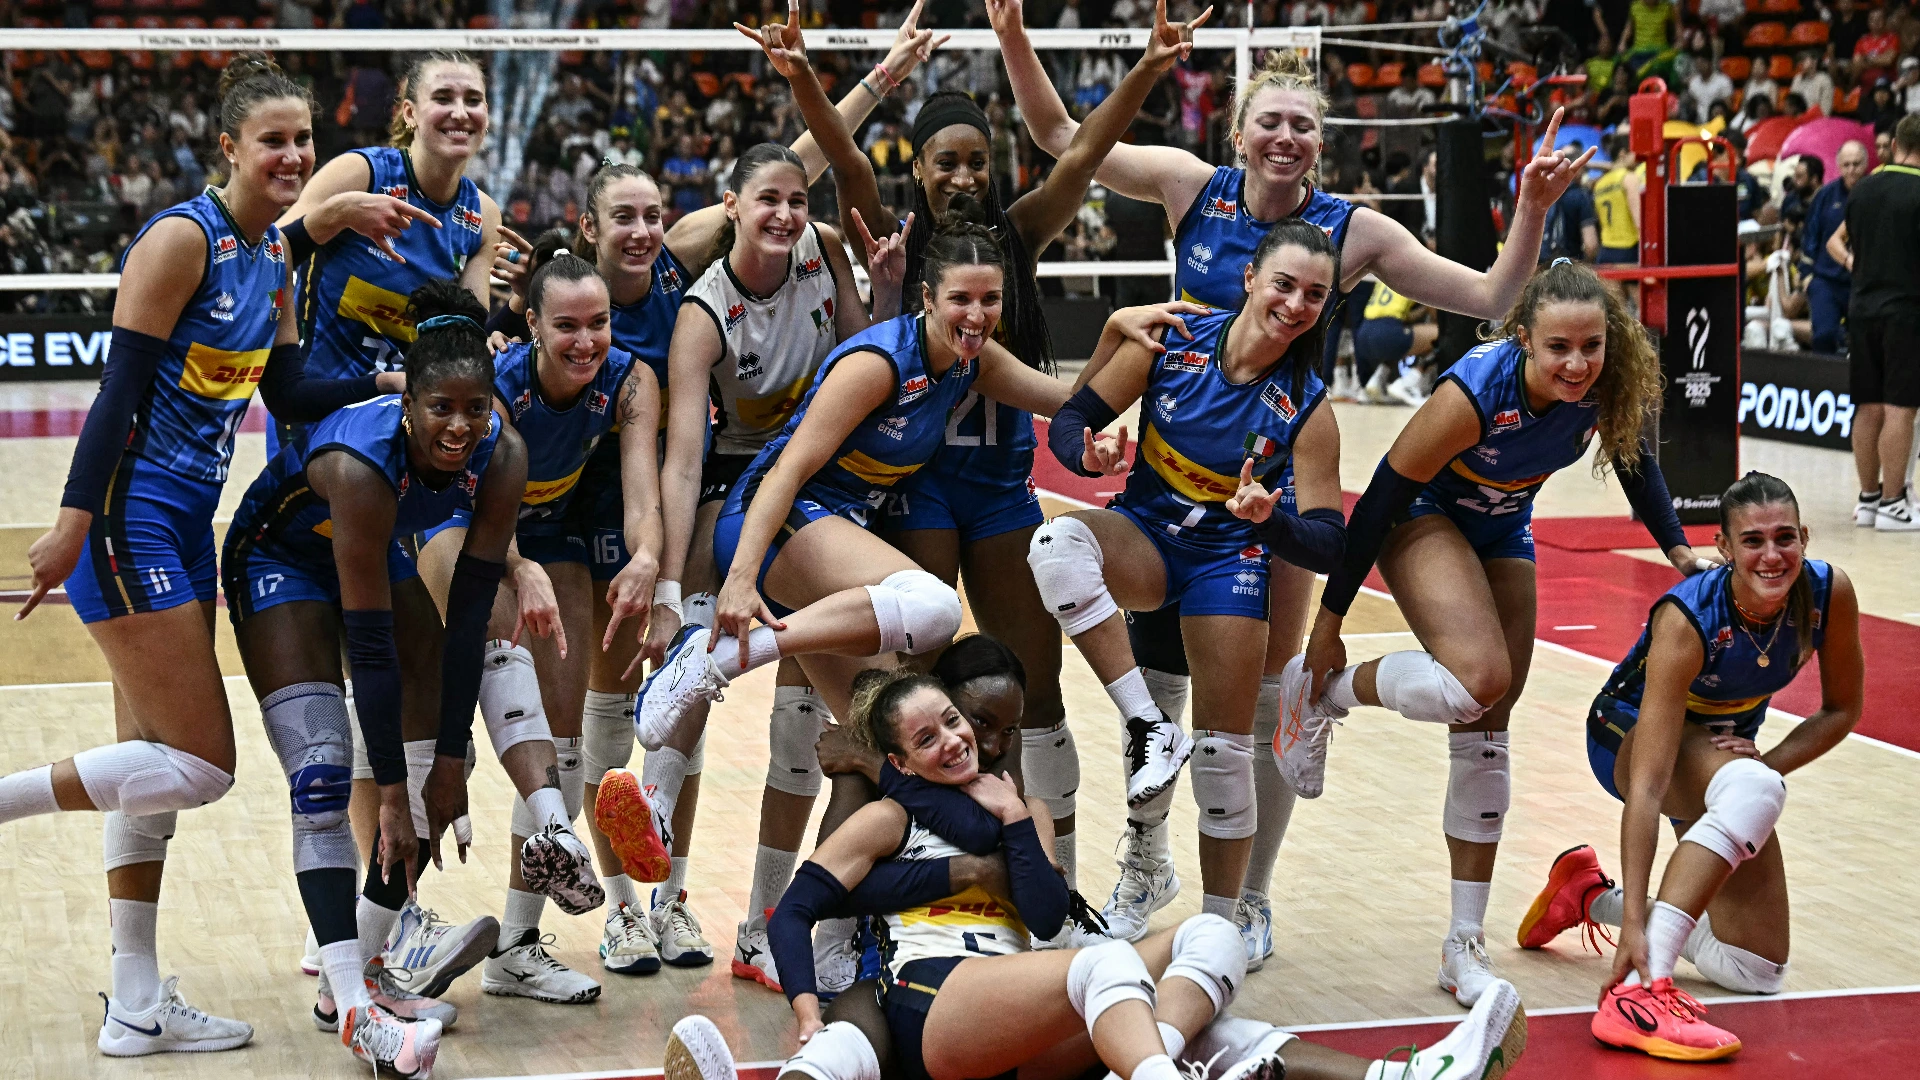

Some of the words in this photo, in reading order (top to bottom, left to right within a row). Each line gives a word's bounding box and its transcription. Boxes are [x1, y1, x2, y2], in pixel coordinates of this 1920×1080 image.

[1187, 255, 1209, 275] errea
[210, 309, 234, 322] errea
[1165, 351, 1208, 366] BigMat
[738, 365, 764, 382] errea
[945, 388, 998, 447] 21
[877, 422, 904, 441] errea
[887, 492, 910, 517] 21
[1166, 492, 1207, 536] 7
[593, 532, 620, 564] 16
[149, 567, 172, 594] 11
[257, 573, 285, 598] 17
[1232, 585, 1260, 597] errea
